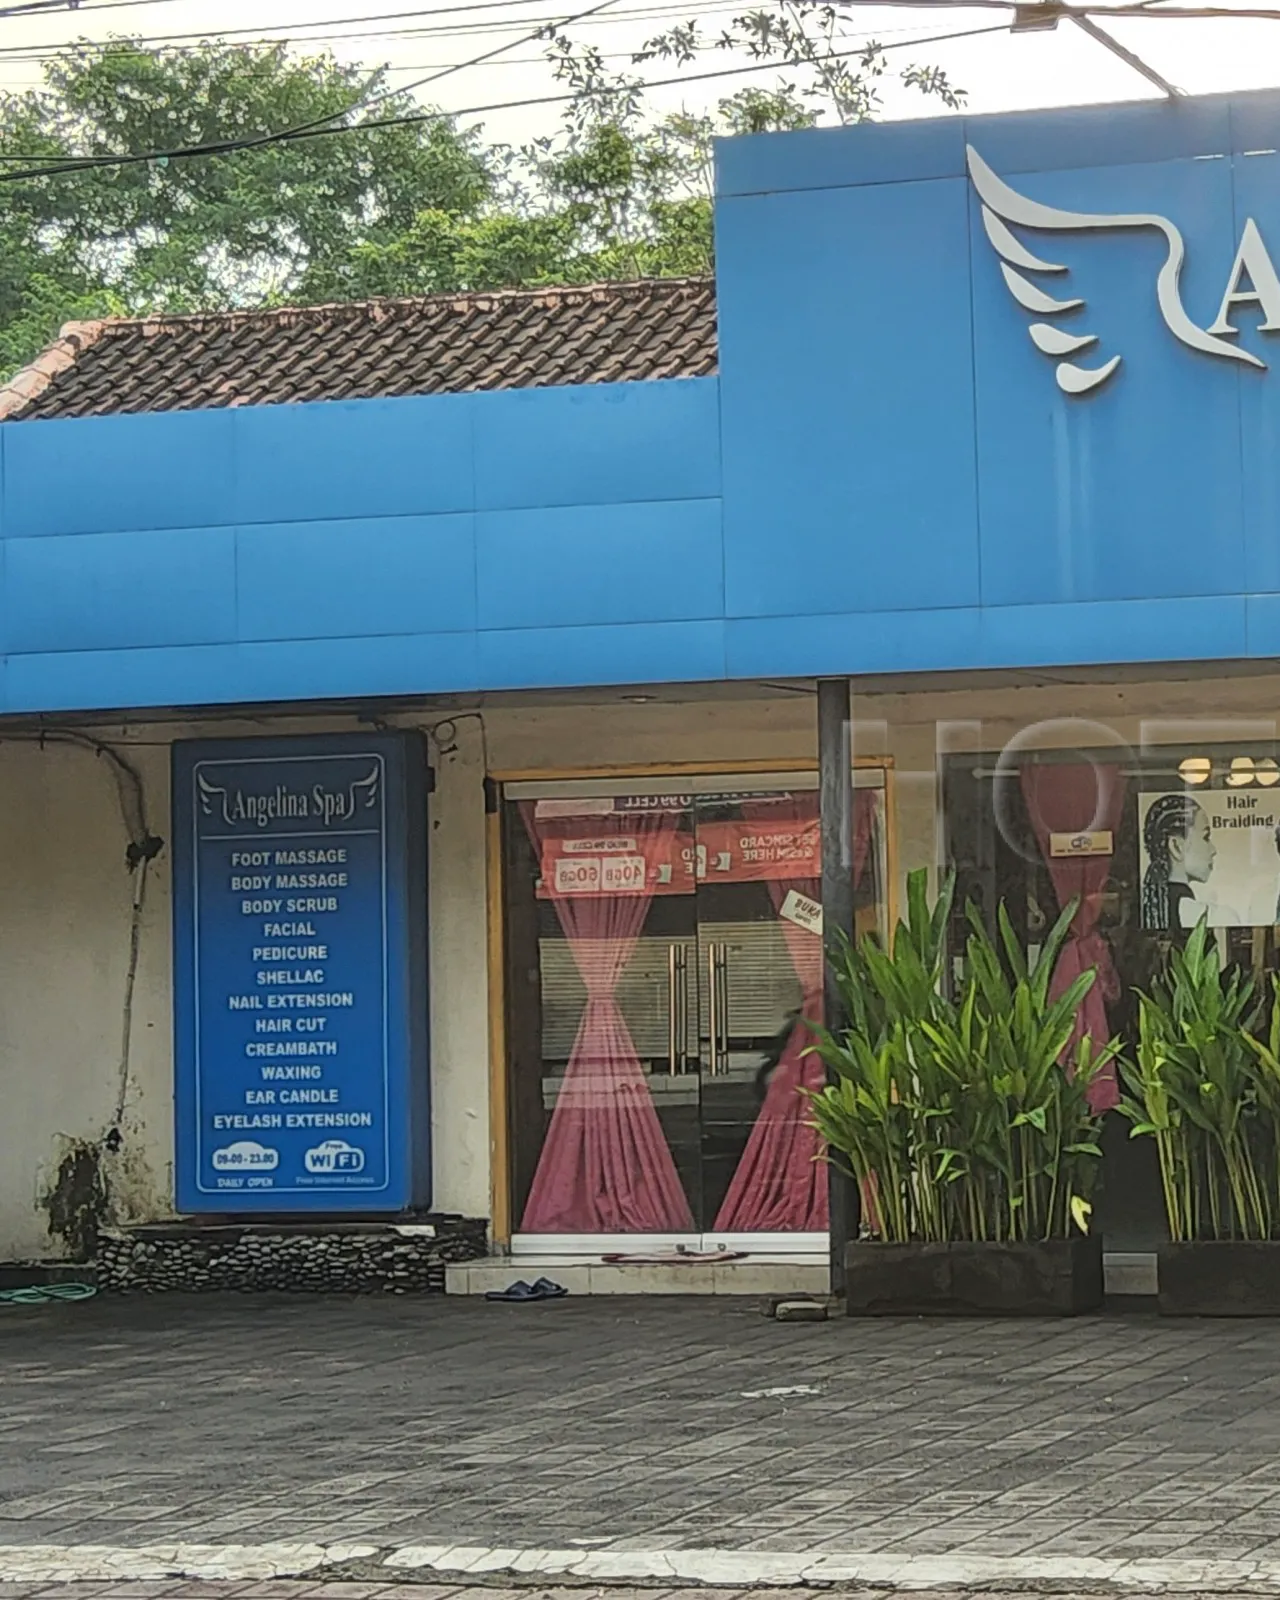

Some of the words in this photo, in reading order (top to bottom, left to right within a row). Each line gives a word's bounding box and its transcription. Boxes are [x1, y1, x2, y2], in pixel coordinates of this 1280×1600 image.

[232, 785, 309, 827] Angelina
[313, 784, 346, 825] Spa
[1227, 795, 1258, 810] Hair
[1211, 813, 1274, 830] Braiding
[231, 852, 271, 867] FOOT
[275, 849, 347, 865] MASSAGE
[231, 876, 272, 891] BODY
[276, 873, 348, 889] MASSAGE
[242, 899, 282, 914] BODY
[286, 897, 338, 912] SCRUB
[794, 898, 821, 920] BUKA
[264, 922, 316, 936] FACIAL
[253, 946, 328, 961] PEDICURE
[256, 969, 324, 985] SHELLAC
[229, 995, 263, 1010] NAIL
[267, 993, 353, 1008] EXTENSION
[255, 1018, 292, 1033] HAIR
[296, 1017, 327, 1032] CUT
[246, 1042, 337, 1056] CREAMBATH
[262, 1066, 322, 1080] WAXING
[246, 1090, 276, 1105] EAR
[279, 1089, 339, 1103] CANDLE
[214, 1115, 281, 1129] EYELASH
[286, 1113, 371, 1127] EXTENSION
